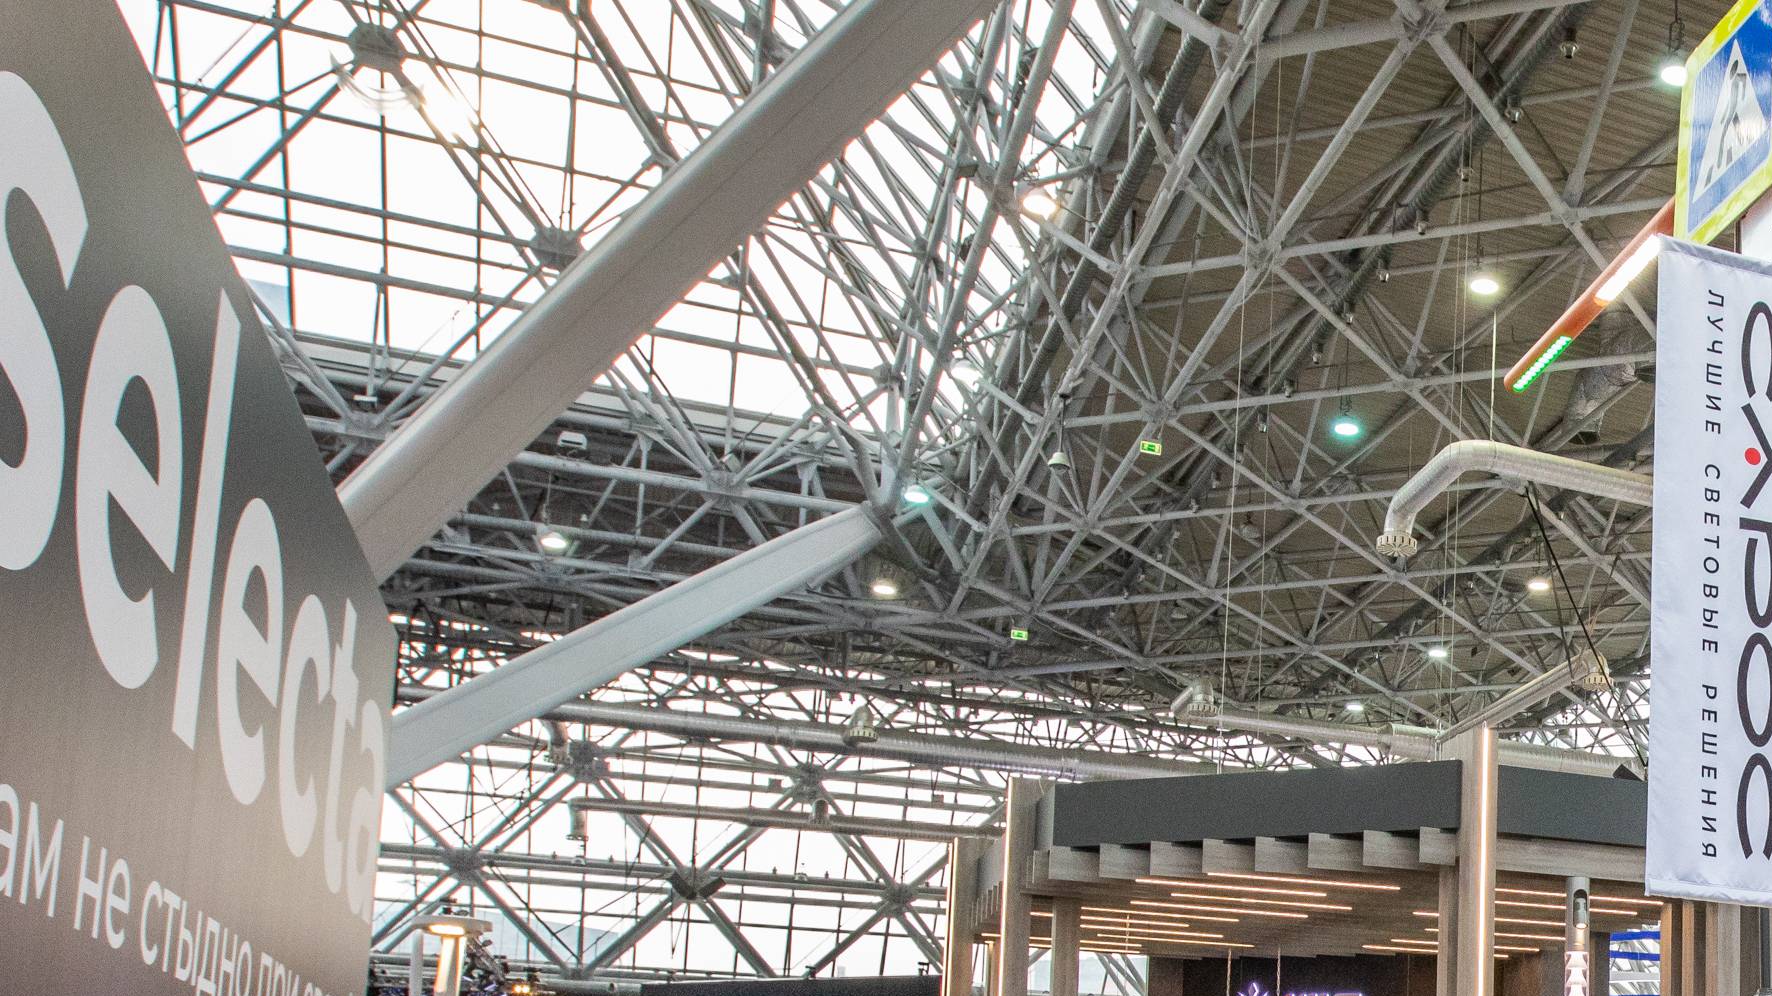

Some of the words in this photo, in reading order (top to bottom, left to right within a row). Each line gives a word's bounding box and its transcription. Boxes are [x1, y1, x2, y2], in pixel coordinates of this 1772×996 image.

[1704, 289, 1725, 434] ЛУЧШИЕ
[1702, 464, 1721, 653] СВЕТОВЫЕ
[1701, 684, 1718, 858] РЕШЕНИЯ
[73, 835, 131, 949] не
